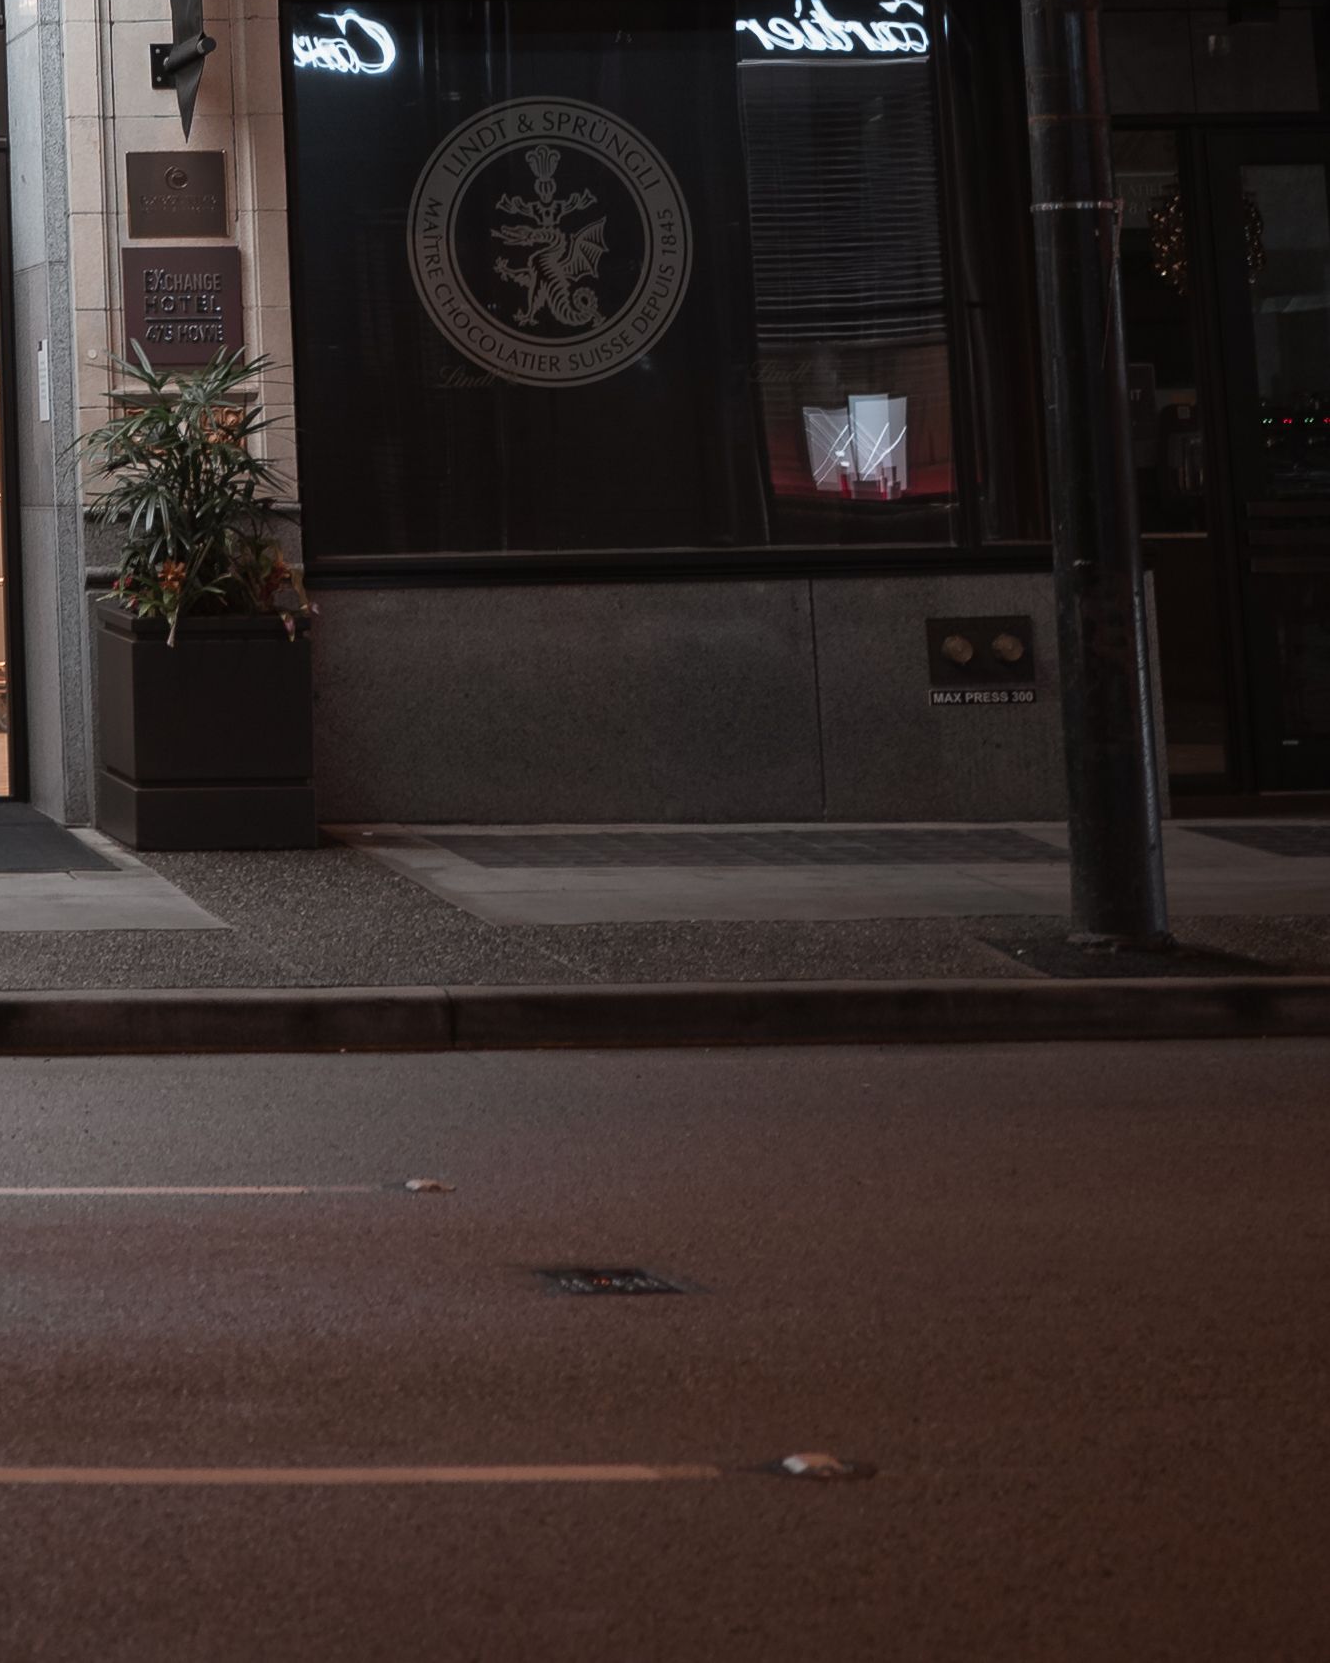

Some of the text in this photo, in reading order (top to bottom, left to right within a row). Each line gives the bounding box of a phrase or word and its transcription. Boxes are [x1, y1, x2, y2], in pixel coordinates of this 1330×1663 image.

[442, 111, 661, 190] LINDT & SPRÜNGLI
[142, 268, 222, 293] EXCHANGE
[422, 197, 677, 371] MAÎTRE CHOCOLATIER SUISSE DEPUIS 1845
[143, 293, 222, 315] HOTEL
[145, 323, 224, 344] 475 HOWE
[933, 691, 1034, 704] MAX PRESS 300
